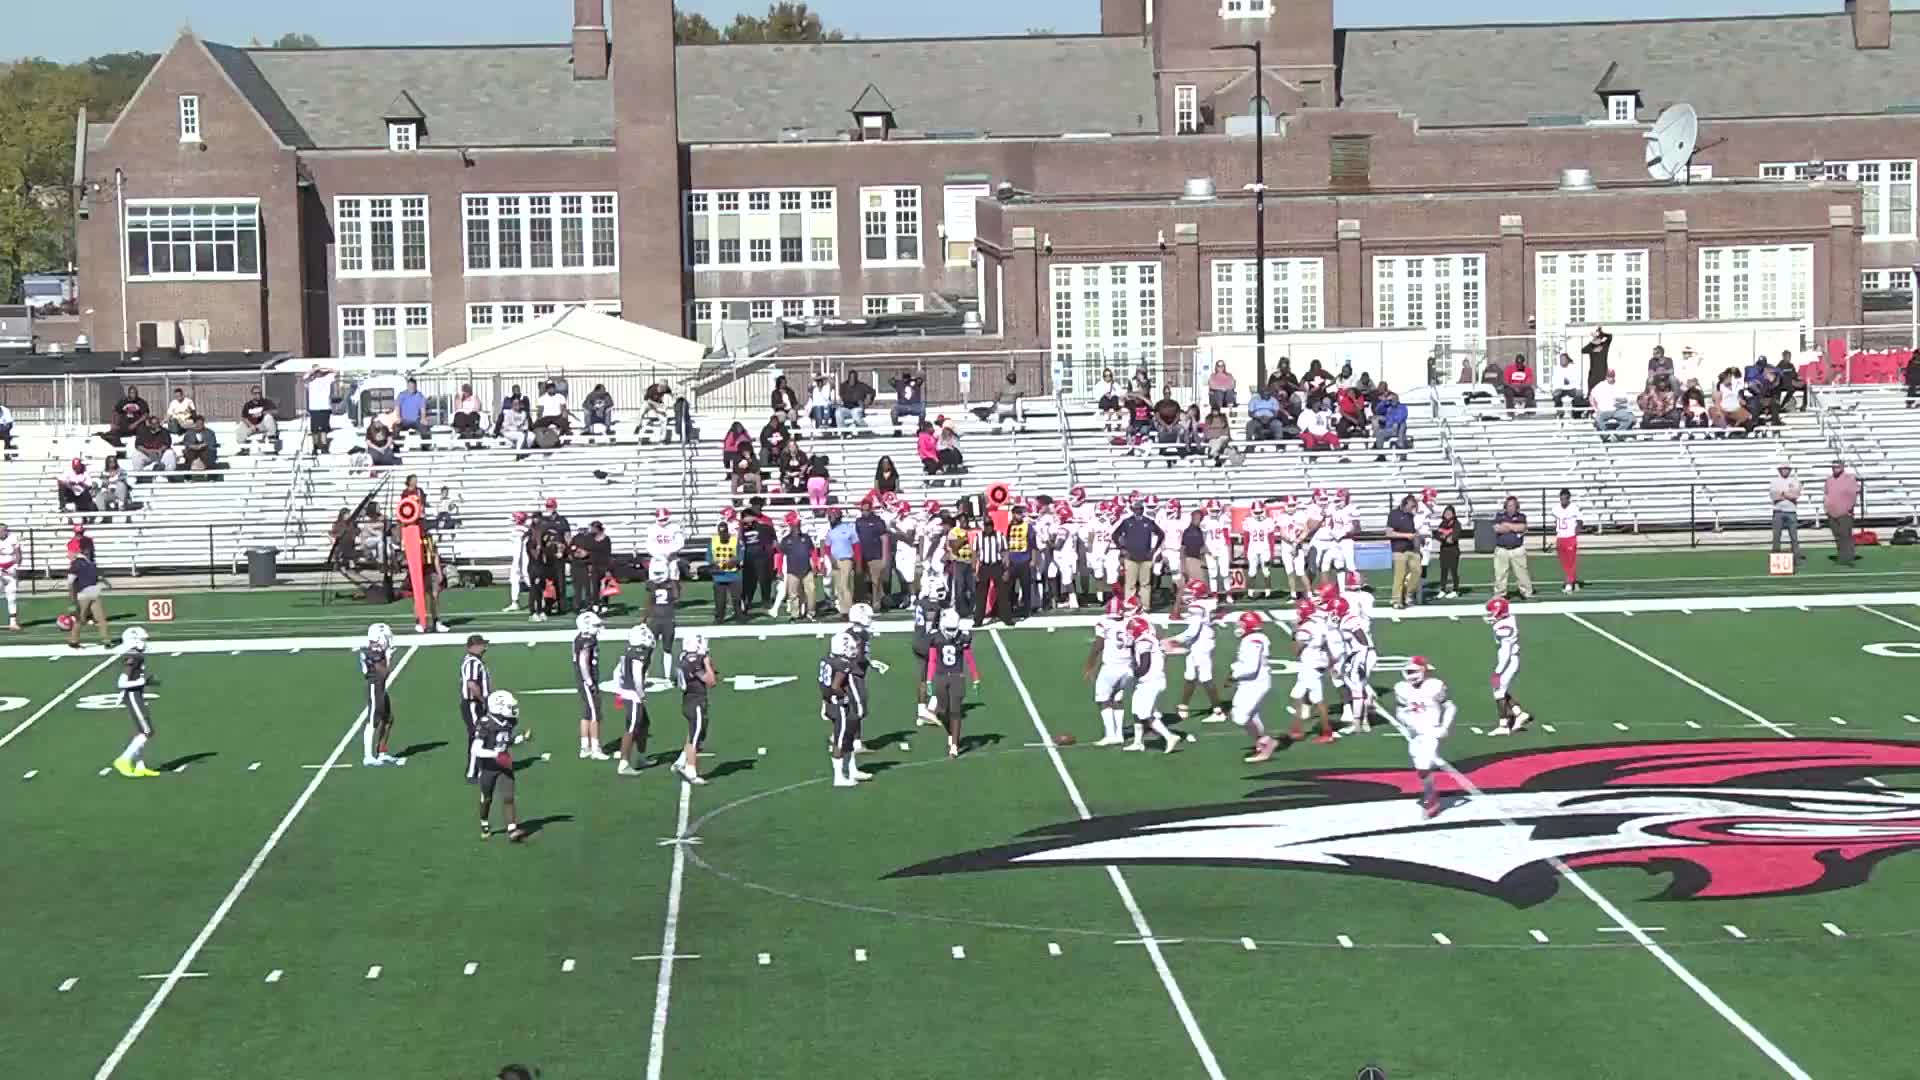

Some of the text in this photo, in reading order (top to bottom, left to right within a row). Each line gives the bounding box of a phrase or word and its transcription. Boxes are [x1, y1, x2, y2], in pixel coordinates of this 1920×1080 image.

[968, 495, 981, 517] 1
[1772, 555, 1791, 571] 40
[655, 588, 669, 605] 2
[151, 601, 171, 617] 30
